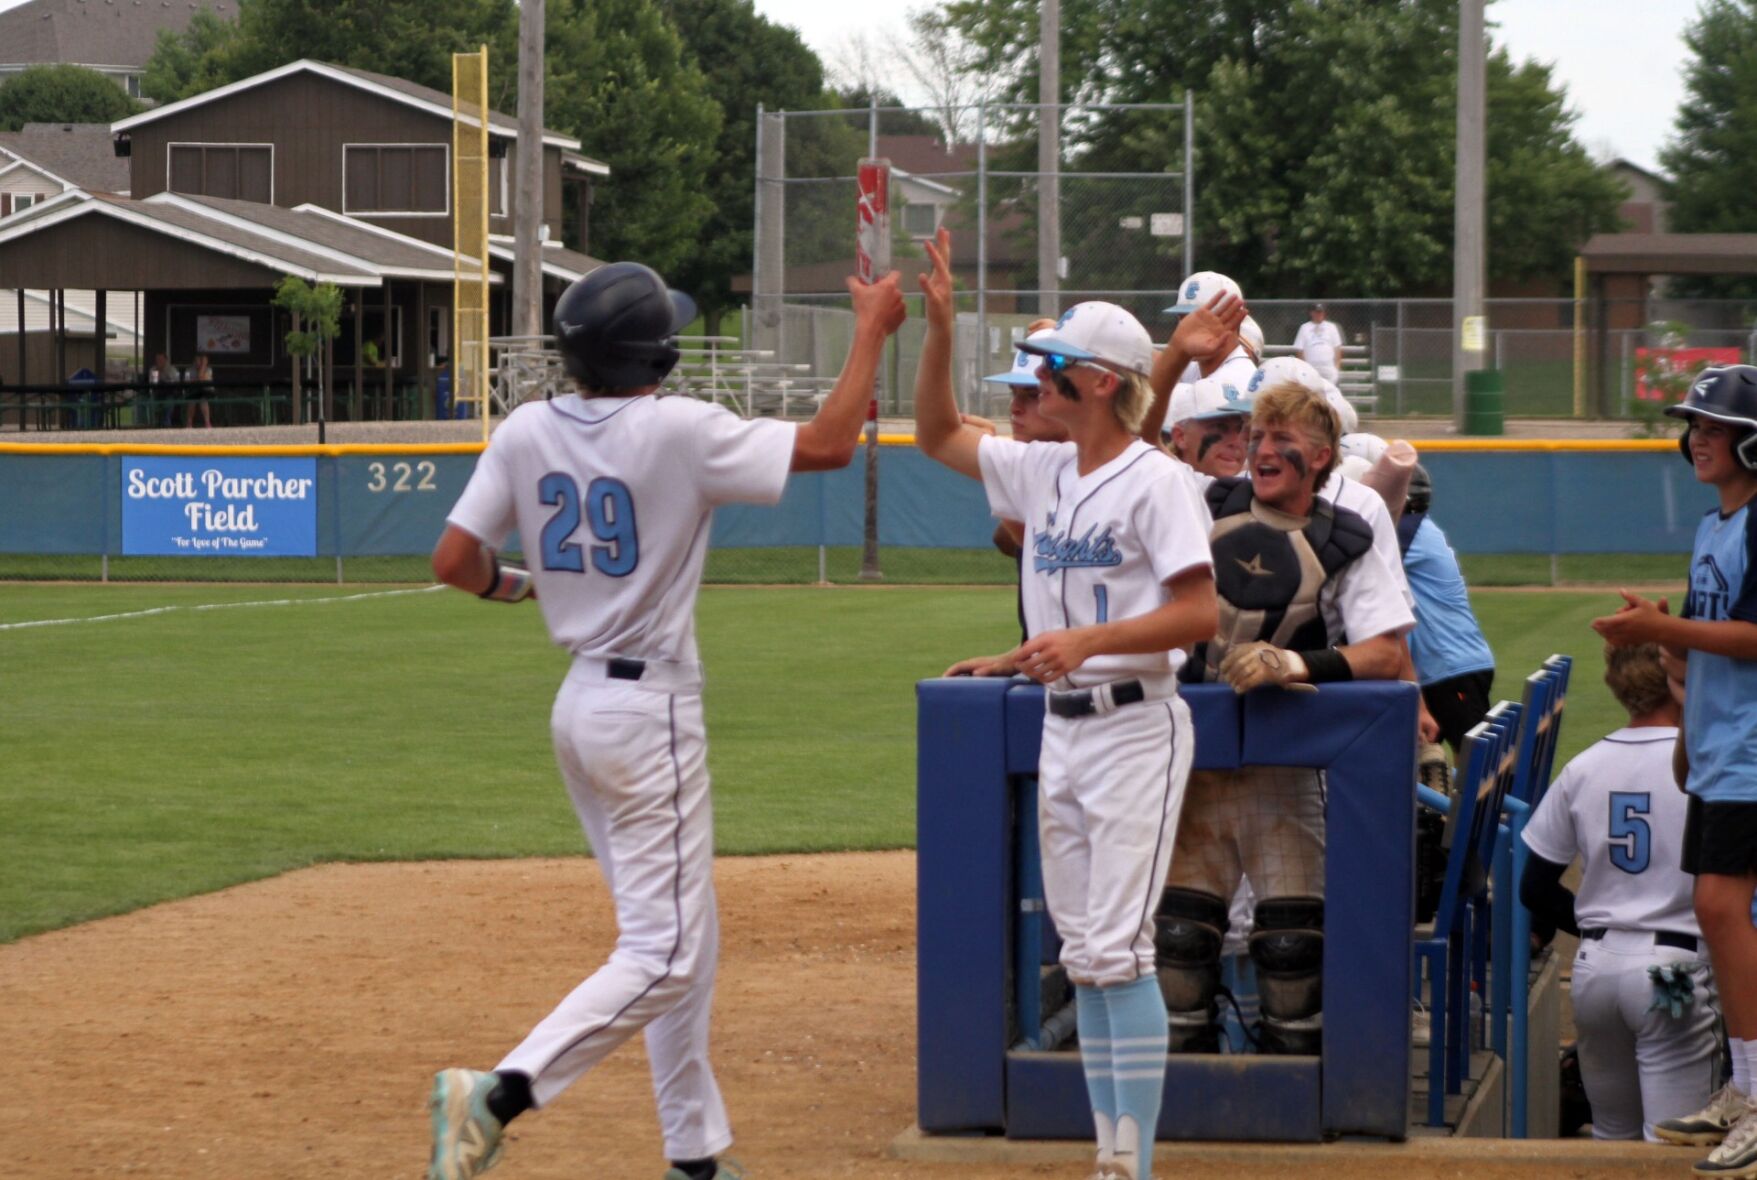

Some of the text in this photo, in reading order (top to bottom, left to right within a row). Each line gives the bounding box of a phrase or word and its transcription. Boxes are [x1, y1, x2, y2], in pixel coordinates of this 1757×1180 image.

[127, 467, 313, 499] Scott Parcher
[367, 460, 437, 492] 322
[184, 501, 260, 532] Field
[537, 470, 640, 578] 29
[192, 536, 210, 549] Love
[211, 536, 221, 550] of
[221, 536, 239, 547] The
[1608, 790, 1651, 875] 5
